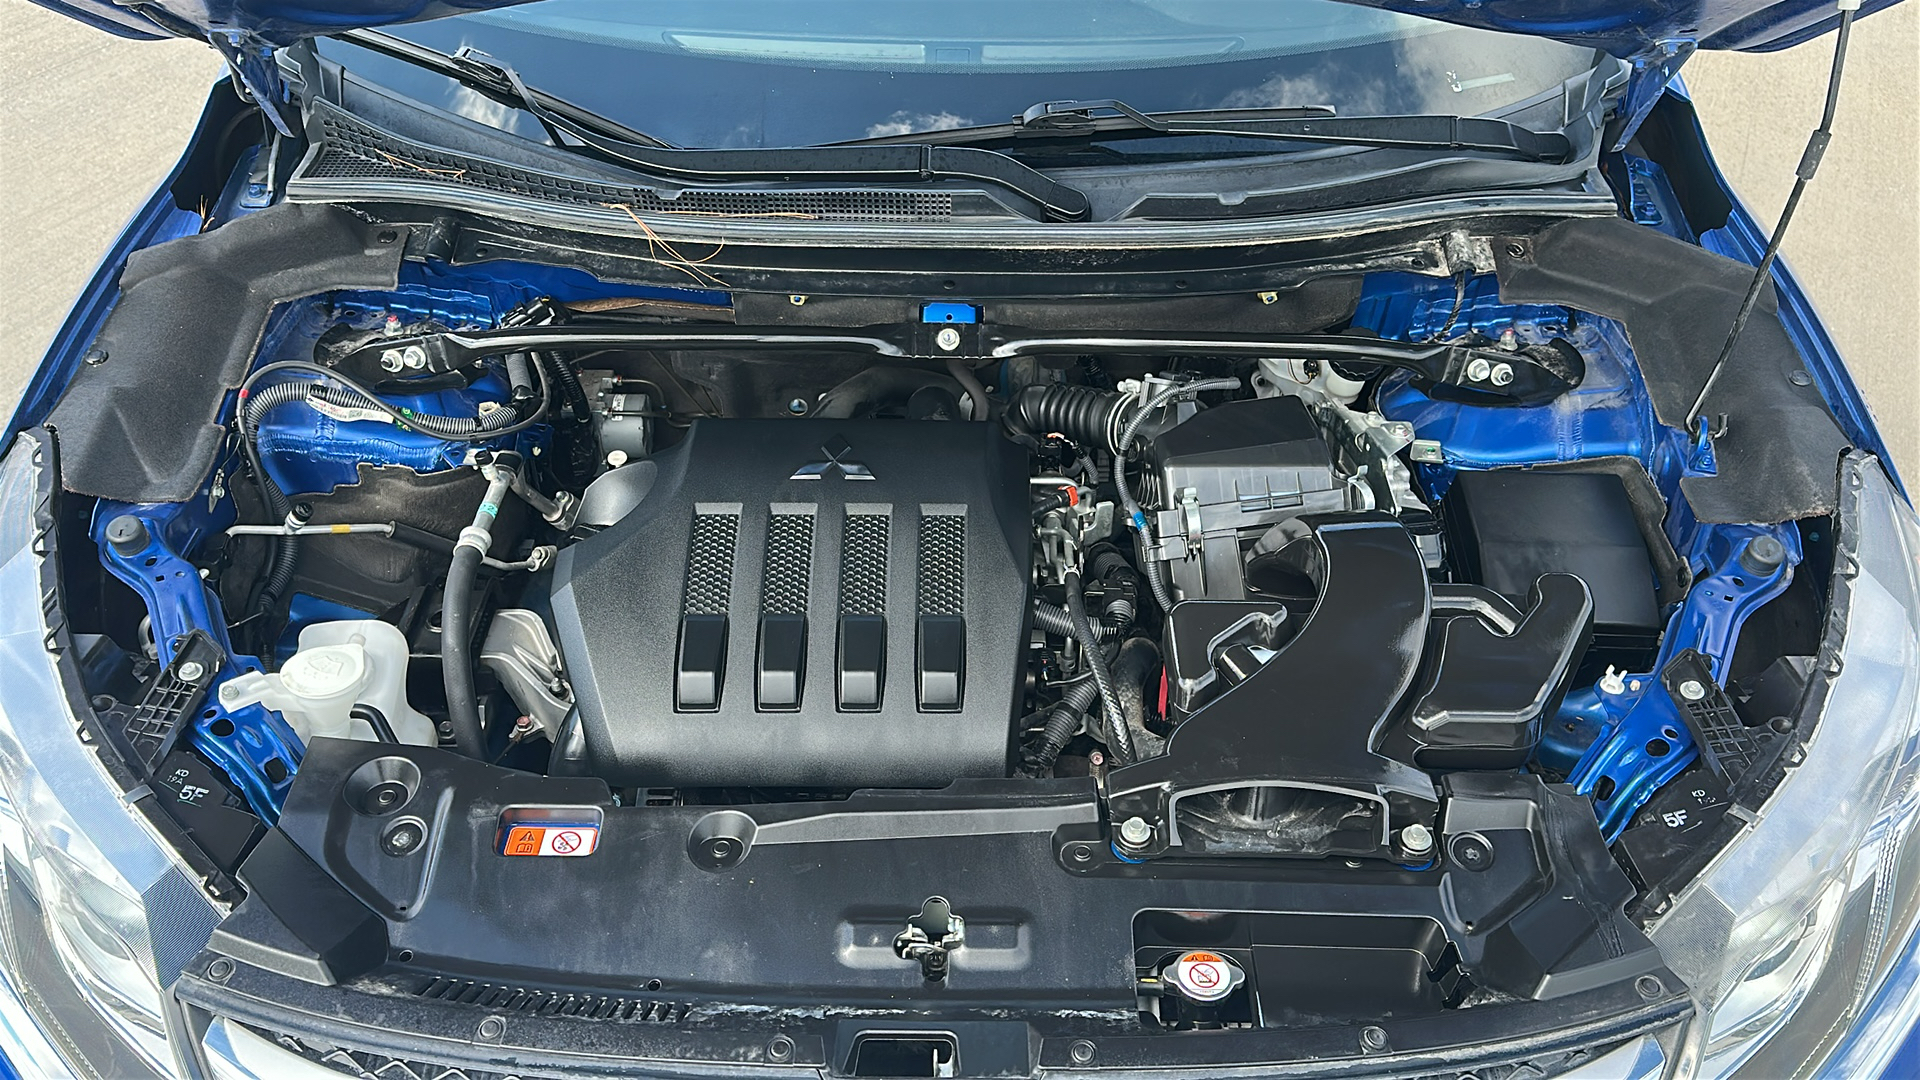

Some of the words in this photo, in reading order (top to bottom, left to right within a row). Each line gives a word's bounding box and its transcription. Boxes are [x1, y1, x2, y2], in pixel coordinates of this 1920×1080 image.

[174, 768, 190, 777] KD
[178, 784, 210, 801] 5F
[1691, 789, 1706, 798] KD
[1662, 809, 1688, 828] 5F
